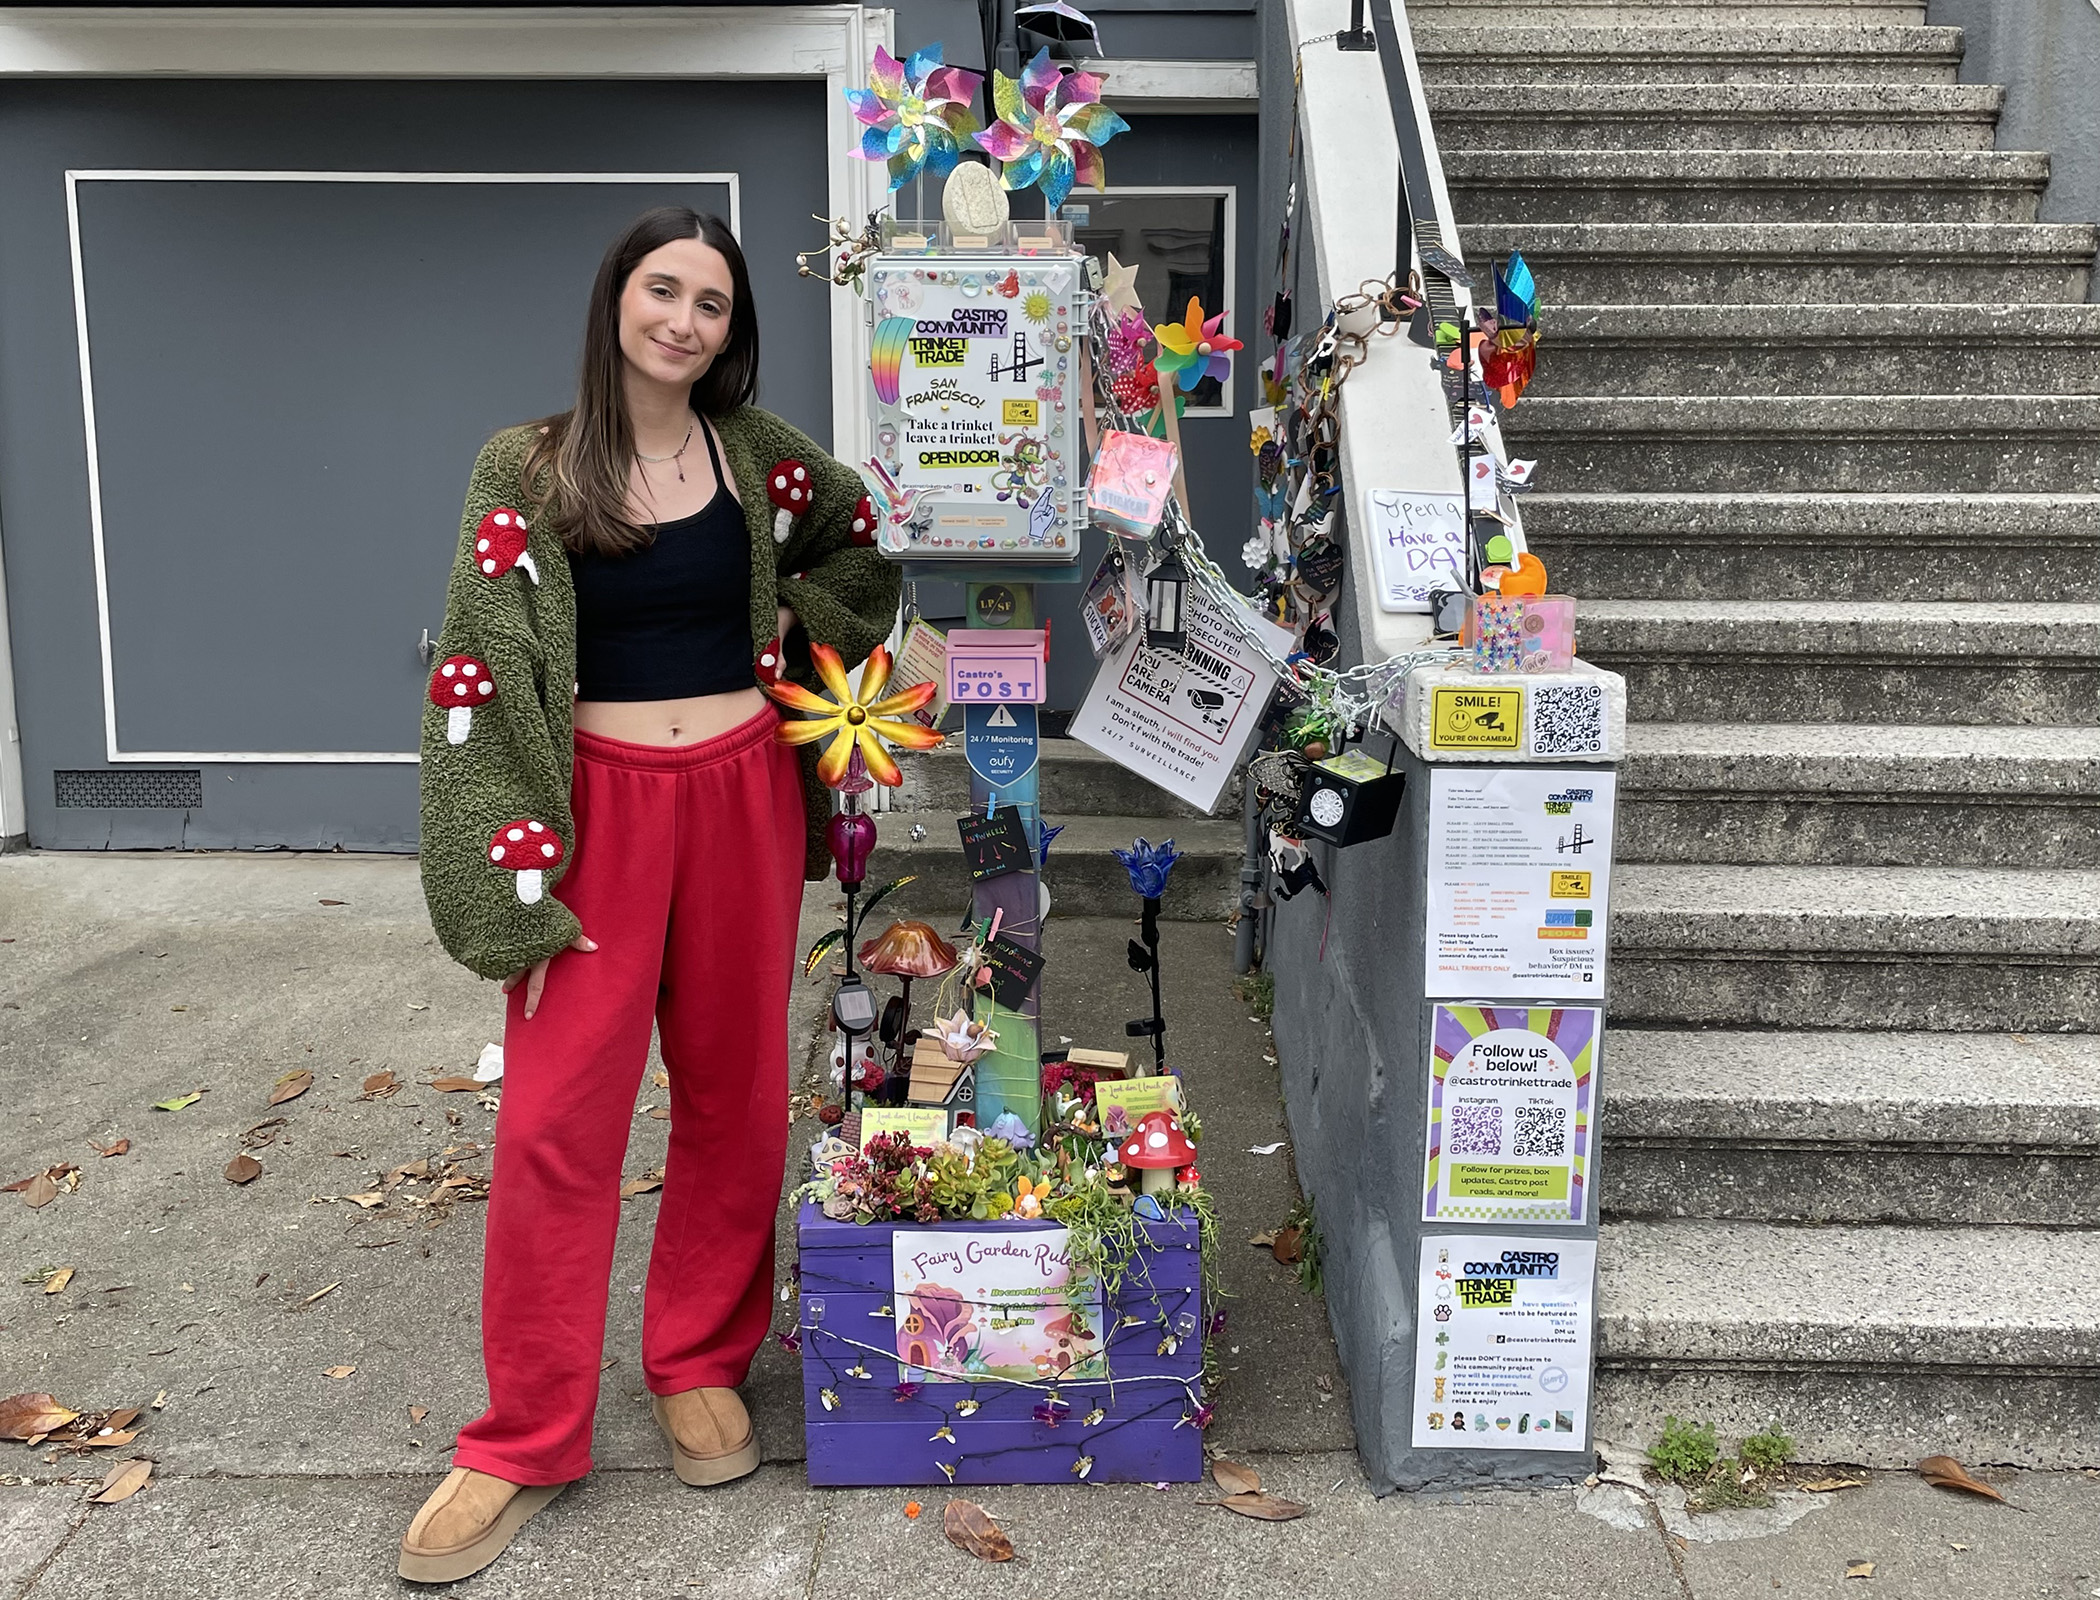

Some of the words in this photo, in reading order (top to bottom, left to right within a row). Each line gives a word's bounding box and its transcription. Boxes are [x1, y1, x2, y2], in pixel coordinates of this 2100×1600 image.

[951, 308, 1008, 321] CASTRO
[916, 320, 1007, 334] COMMUNITY
[908, 337, 969, 350] TRINKET
[915, 350, 964, 363] TRADE
[930, 378, 958, 389] SAN
[906, 389, 985, 409] FRANCISCO!
[908, 419, 939, 430] Take
[941, 421, 948, 430] a
[951, 420, 993, 431] trinket
[906, 432, 937, 443] leave
[939, 434, 946, 443] a
[949, 433, 995, 444] trinket!
[919, 451, 958, 465] OPEN
[959, 450, 1000, 463] DOOR
[1388, 528, 1438, 547] Have
[1445, 532, 1462, 543] a
[980, 599, 994, 608] LP
[1223, 629, 1243, 643] and
[958, 670, 1003, 678] Castro's
[958, 682, 1031, 697] POST
[1126, 675, 1171, 705] CAMERA
[1454, 696, 1501, 708] SMILE!
[1110, 698, 1124, 710] am
[1131, 710, 1160, 732] sleuth,
[1167, 729, 1183, 743] will
[1184, 738, 1201, 752] find
[1201, 748, 1220, 764] you.
[990, 736, 1033, 745] Monitoring
[1111, 713, 1135, 731] Don't
[1136, 725, 1142, 733] f
[1142, 730, 1160, 745] with
[1162, 740, 1177, 753] the
[1178, 749, 1205, 769] trade!
[989, 756, 1015, 768] eufy
[1129, 741, 1197, 782] SURVEILLANCE
[1545, 913, 1574, 924] SUPPORT
[1473, 1045, 1524, 1057] Follow
[1529, 1049, 1548, 1058] us
[1486, 1059, 1537, 1072] below!
[1449, 1076, 1572, 1088] @castrotrinkettrade
[1459, 1097, 1498, 1105] Instagram
[1504, 1167, 1532, 1176] prizes,
[1461, 1177, 1497, 1185] updates,
[911, 1250, 963, 1279] Fairy
[966, 1240, 1032, 1264] Garden
[1500, 1251, 1559, 1264] CASTRO
[1463, 1262, 1558, 1276] COMMUNITY
[1455, 1279, 1517, 1291] TRINKET
[1004, 1287, 1041, 1297] careful,
[1461, 1291, 1512, 1305] TRADE
[1018, 1317, 1034, 1325] fun
